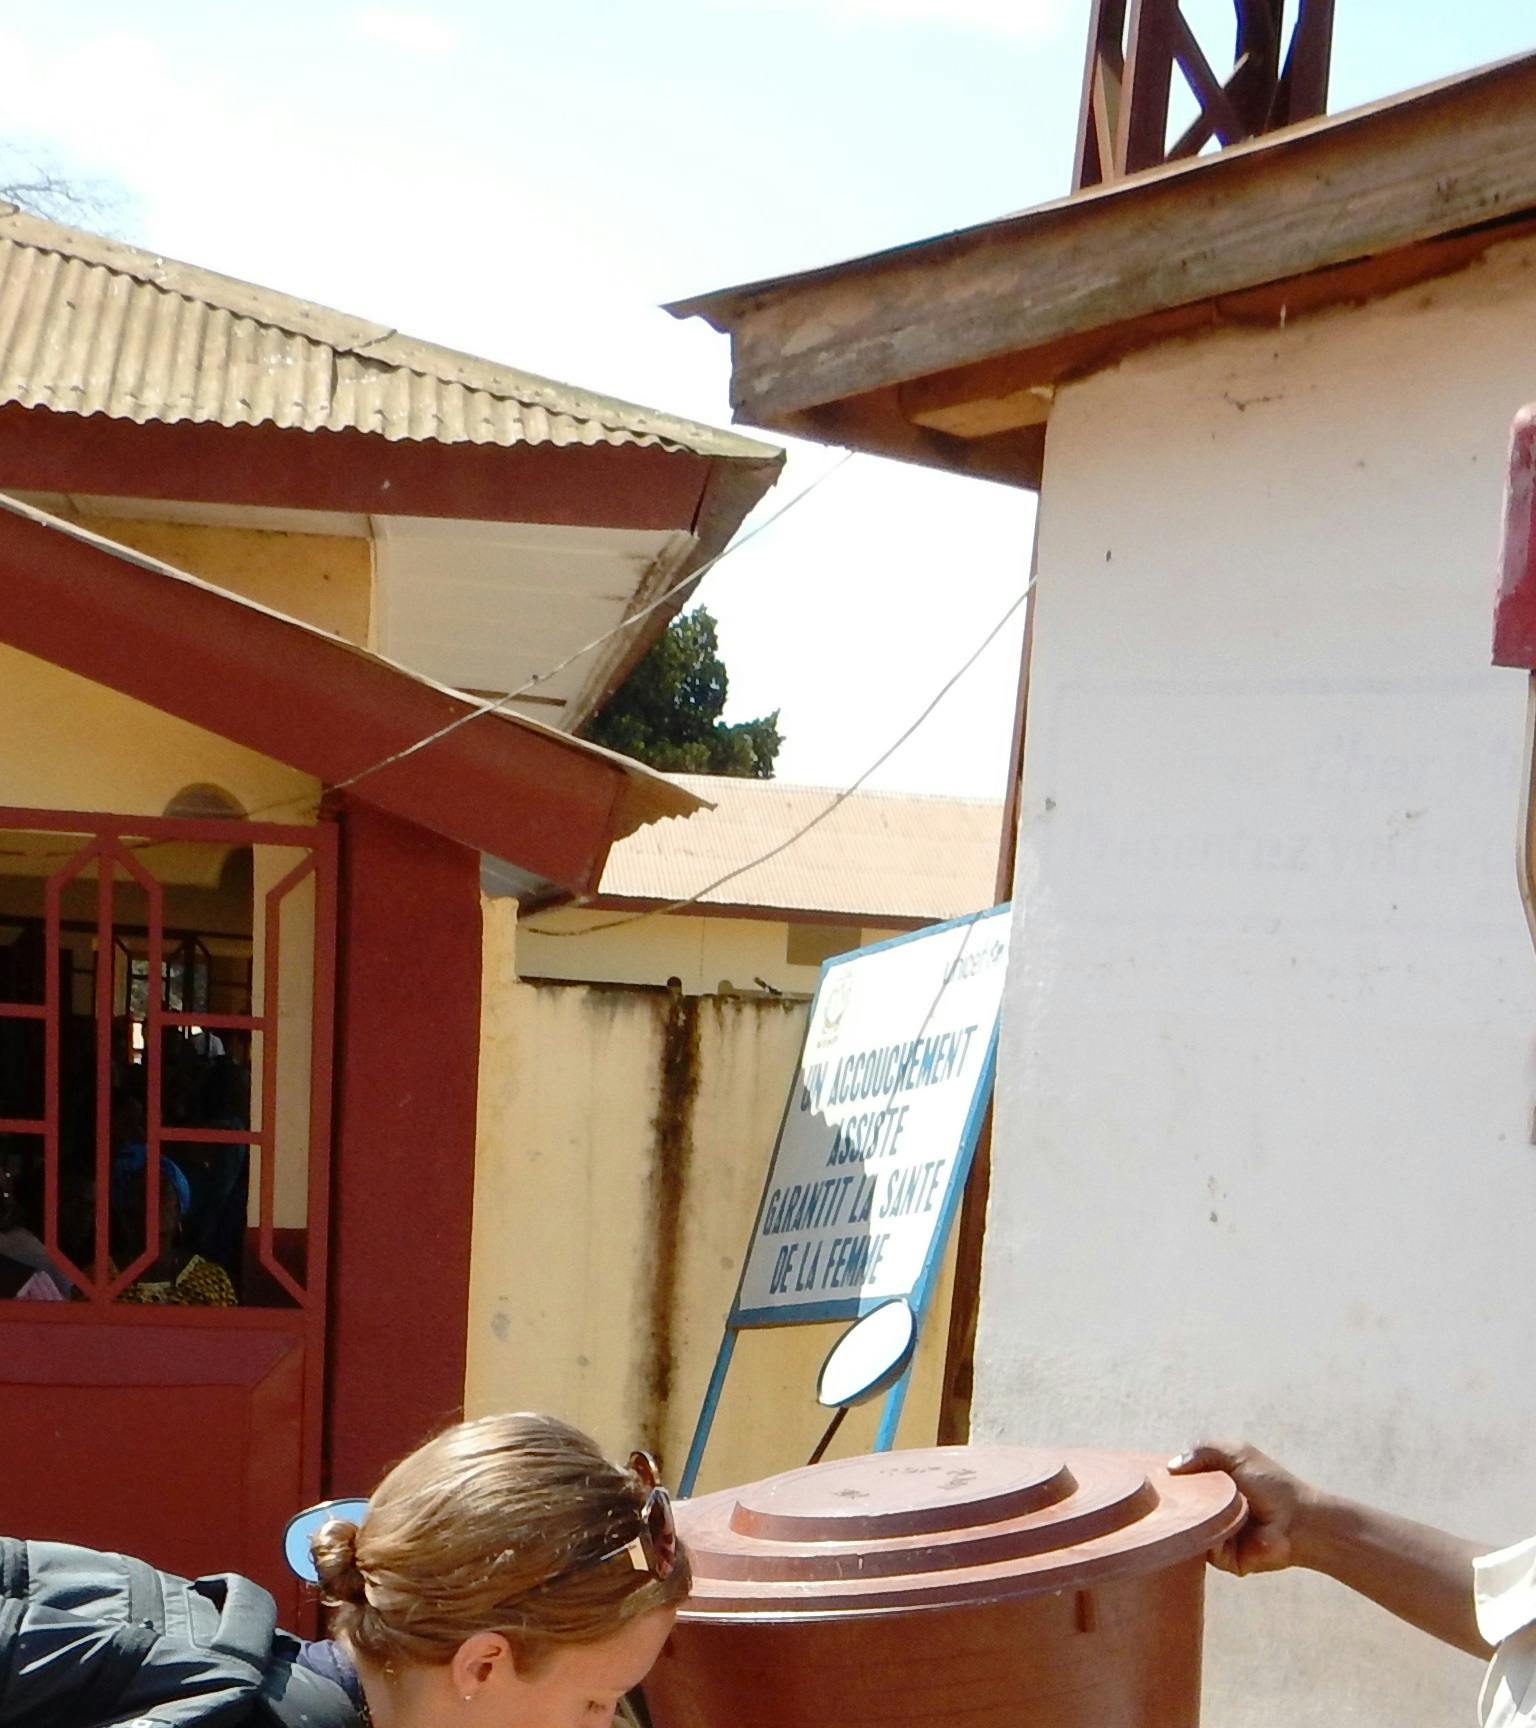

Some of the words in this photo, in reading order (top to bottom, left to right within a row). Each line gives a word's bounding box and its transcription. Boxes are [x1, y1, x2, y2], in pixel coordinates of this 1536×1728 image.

[800, 1060, 830, 1112] UN
[826, 1024, 978, 1107] ACCOUCHEMENT
[825, 1104, 910, 1167] ASSISTE
[762, 1175, 855, 1236] GARANTIT
[847, 1172, 879, 1224] LA
[878, 1158, 946, 1219] SANTE
[769, 1243, 799, 1295] DE
[794, 1240, 824, 1293] LA
[820, 1233, 890, 1289] FEMME
